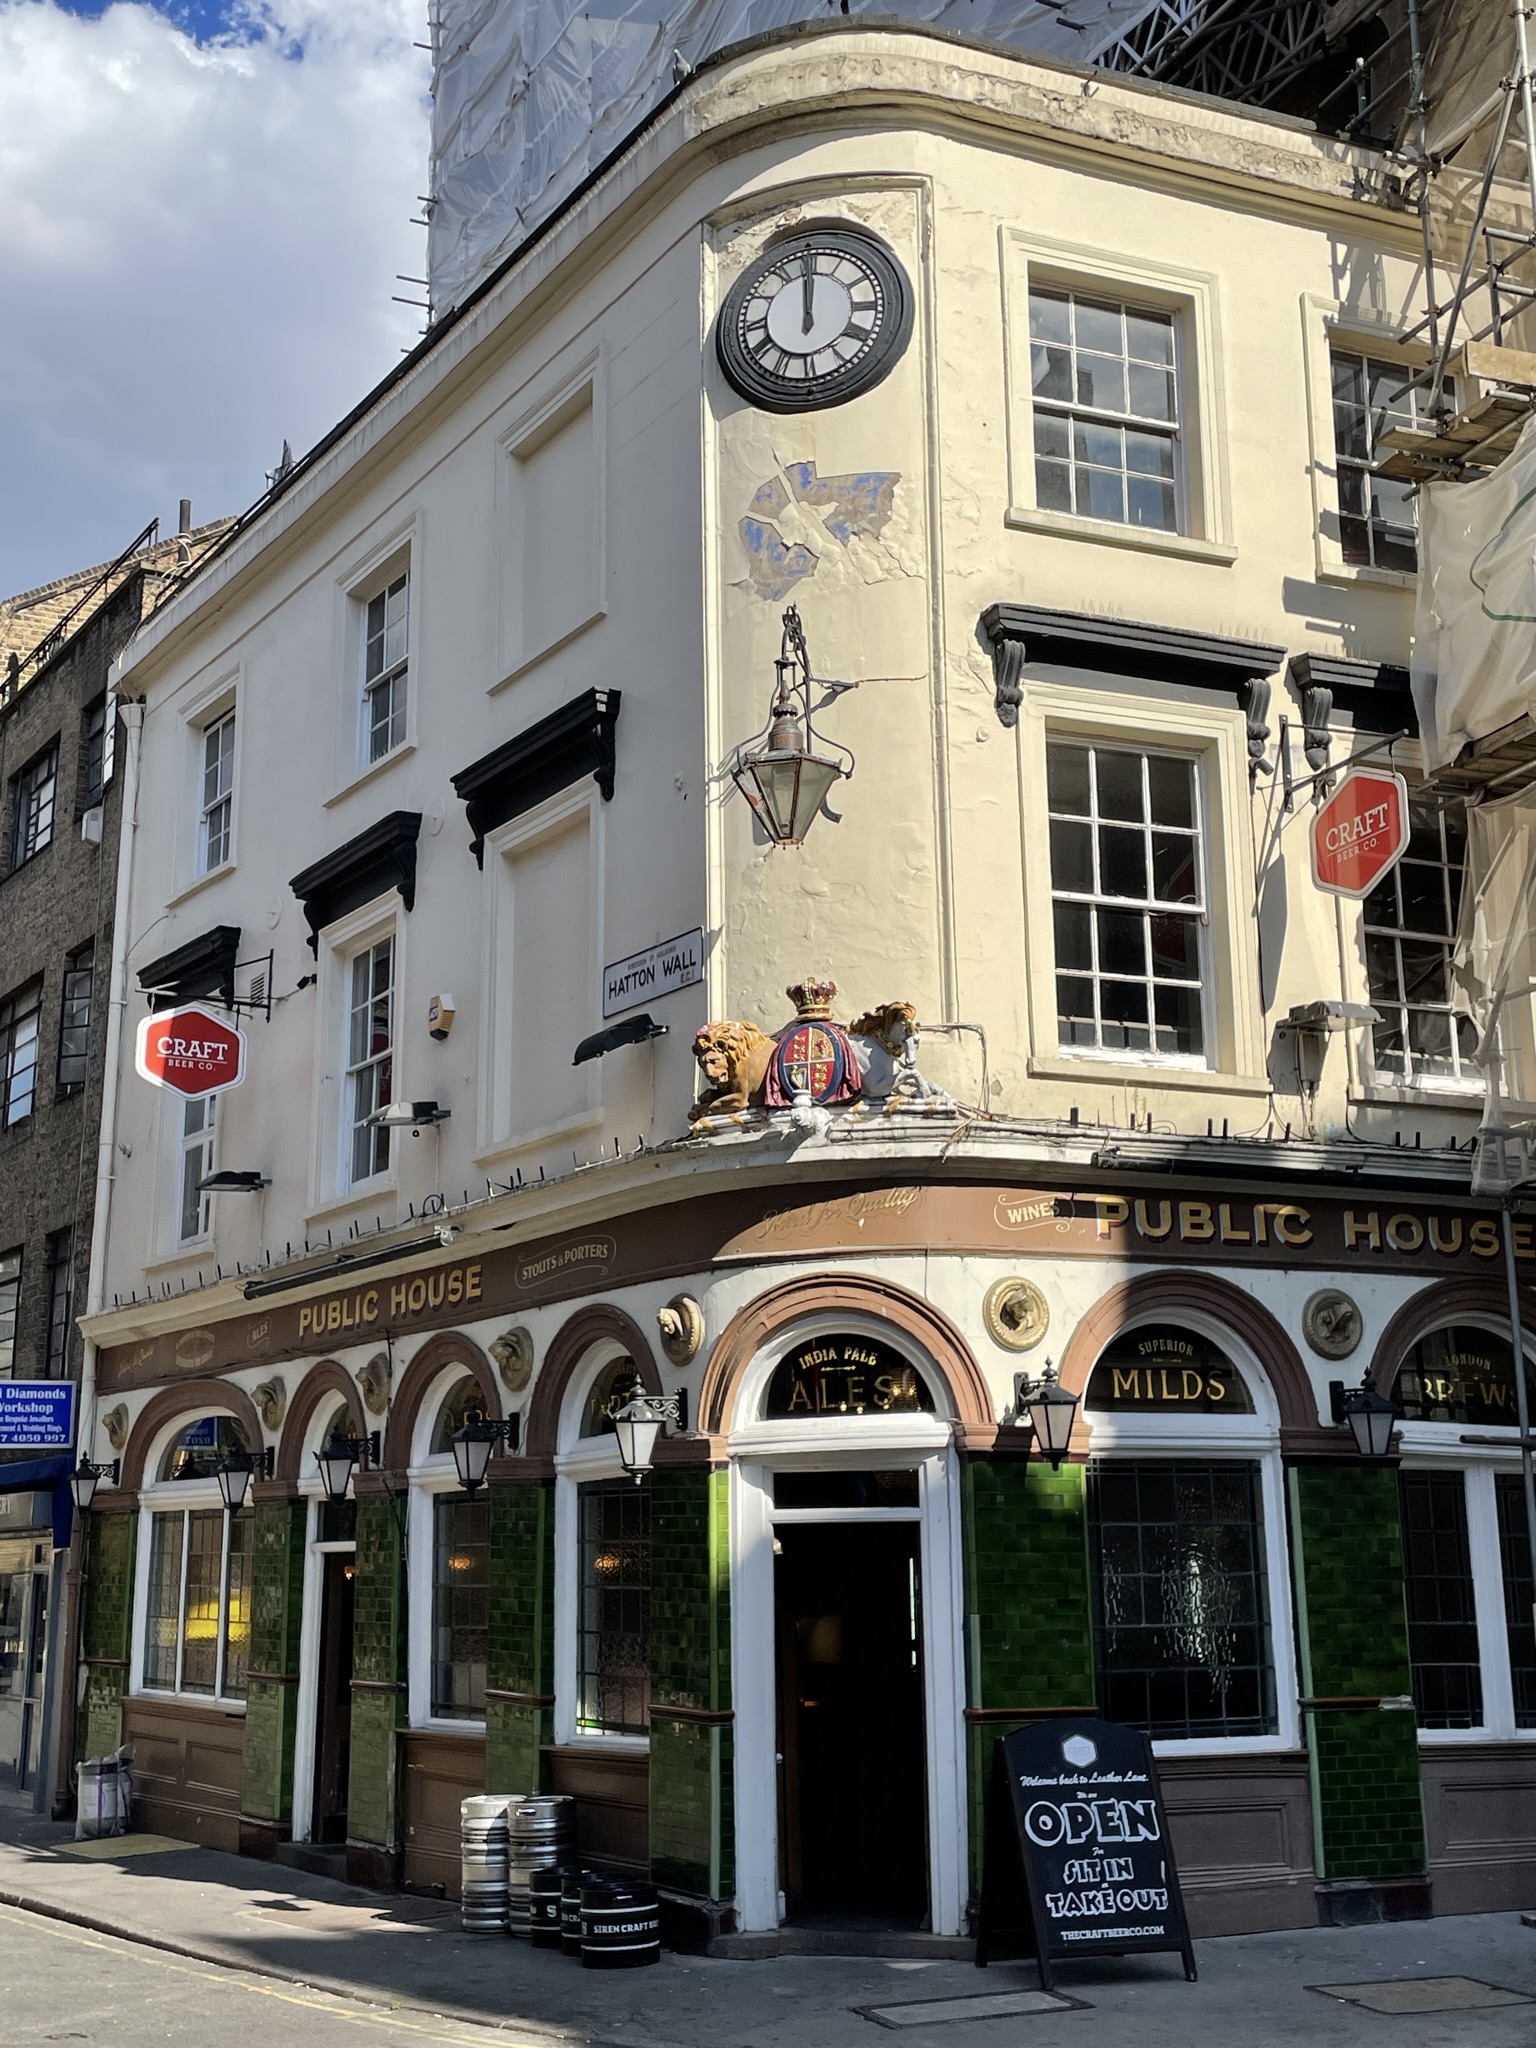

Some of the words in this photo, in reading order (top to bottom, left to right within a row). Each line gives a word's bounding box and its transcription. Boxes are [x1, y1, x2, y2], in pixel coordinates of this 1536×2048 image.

[1326, 803, 1388, 851] CRAFT
[1336, 845, 1360, 863] BEER
[608, 964, 655, 1000] HATTON
[662, 948, 697, 978] WALL
[157, 1036, 229, 1061] CRAFT
[168, 1058, 194, 1069] BEER
[198, 1062, 216, 1071] CO.
[846, 1187, 917, 1221] Quality
[1006, 1200, 1060, 1224] WINES
[1095, 1195, 1314, 1246] PUBLIC
[1343, 1209, 1536, 1259] HOUSE
[522, 1255, 557, 1281] STOUTS
[564, 1244, 609, 1264] PORTERS
[299, 1289, 380, 1337] PUBLIC
[390, 1264, 483, 1318] HOUSE
[251, 1321, 268, 1341] ALES
[798, 1347, 838, 1370] INDIA
[844, 1346, 879, 1366] PALE
[1138, 1339, 1194, 1357] SUPERIOR
[1445, 1353, 1491, 1371] LONDON
[6, 1387, 67, 1400] Diamonds
[789, 1375, 895, 1411] ALES
[1112, 1368, 1226, 1400] MILDS
[11, 1434, 41, 1442] 4050
[44, 1434, 66, 1442] 997
[1020, 1776, 1057, 1787] Welcome
[1059, 1773, 1078, 1786] back
[1079, 1776, 1088, 1785] to
[1089, 1771, 1122, 1784] Leather
[1024, 1797, 1160, 1847] OPEN
[1063, 1858, 1101, 1885] SIT
[1102, 1857, 1134, 1881] IN
[1045, 1888, 1116, 1918] TAKE
[1116, 1888, 1169, 1912] OUT
[593, 1924, 620, 1934] SIREN
[621, 1921, 648, 1933] CRAFT
[1060, 1925, 1166, 1941] THECRAFTBEERCO.COM
